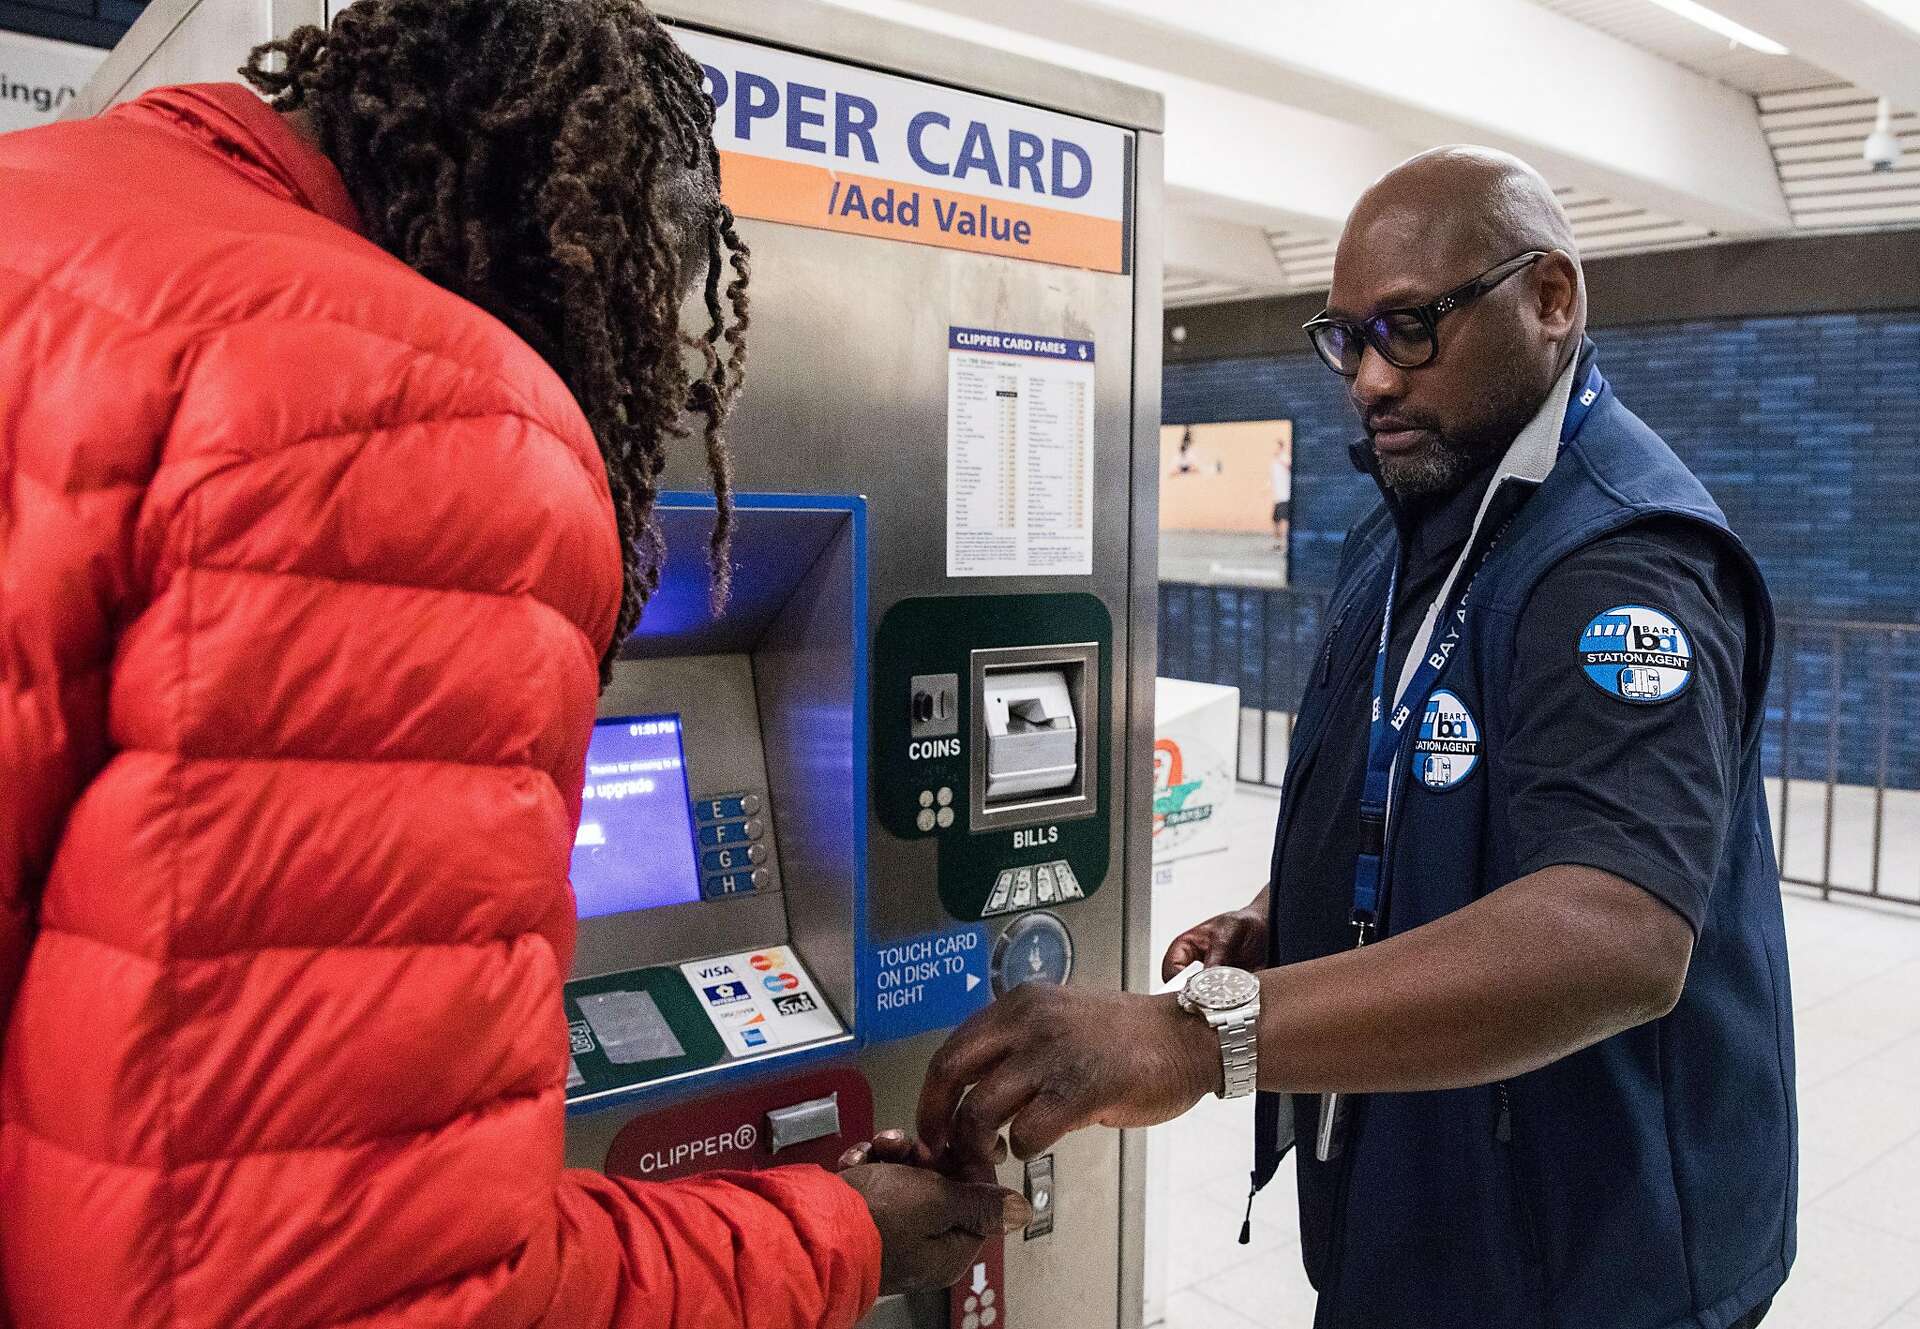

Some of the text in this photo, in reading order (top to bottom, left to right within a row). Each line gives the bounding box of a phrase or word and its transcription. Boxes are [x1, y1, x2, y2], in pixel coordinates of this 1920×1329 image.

[907, 111, 1094, 200] CARD
[932, 198, 1033, 246] Value
[956, 332, 1067, 355] CLIPPER CARD FARES
[1642, 625, 1678, 635] BART
[1428, 626, 1460, 670] BAY
[1587, 652, 1689, 668] STATION AGENT
[1443, 712, 1467, 721] BART
[908, 738, 961, 760] COINS
[1416, 740, 1477, 754] ATION AGENT
[713, 803, 724, 818] E
[717, 826, 726, 842] F
[1013, 825, 1059, 849] BILLS
[719, 851, 732, 868] G
[722, 876, 736, 893] H
[877, 931, 978, 968] TOUCH CARD
[699, 964, 734, 979] VISA
[877, 954, 965, 990] ON DISK TO
[876, 984, 925, 1012] RIGHT
